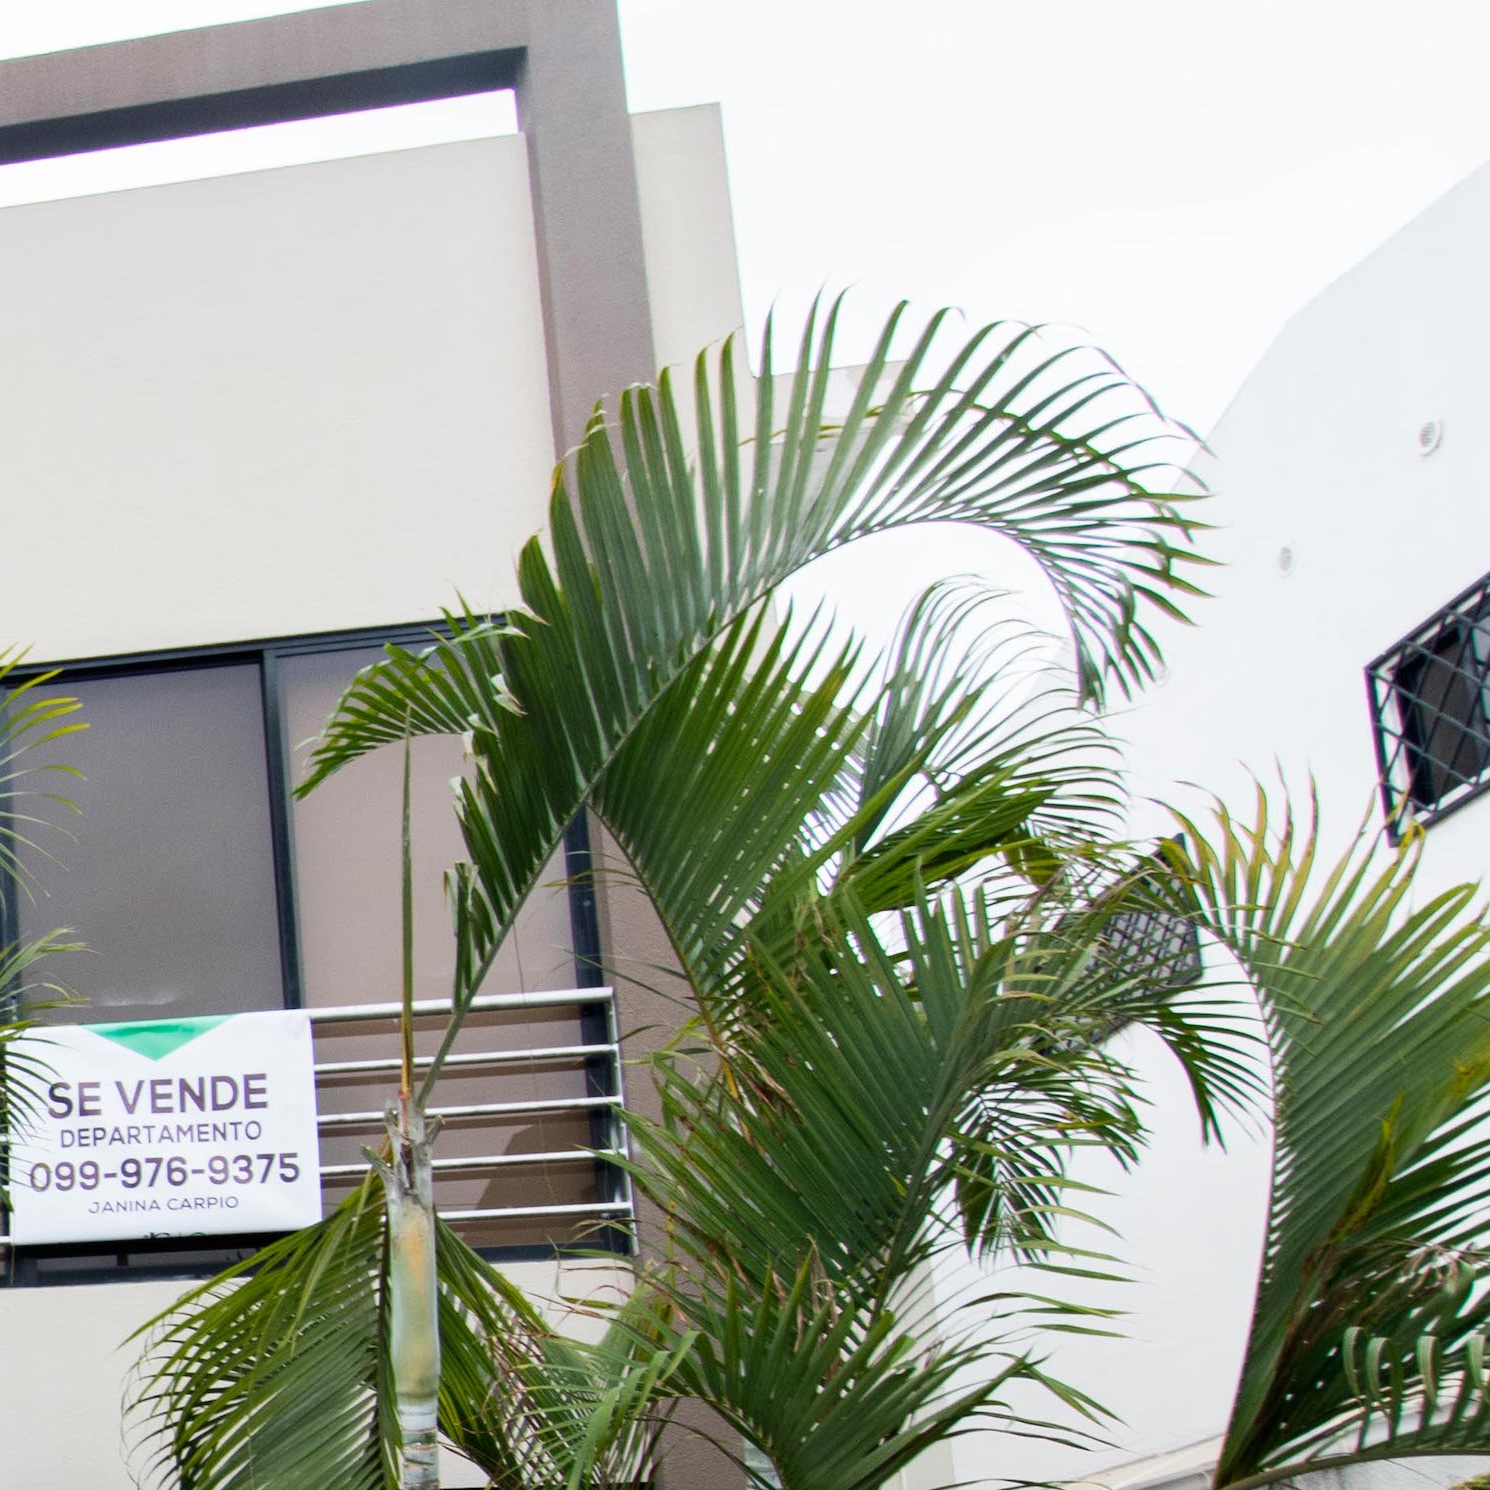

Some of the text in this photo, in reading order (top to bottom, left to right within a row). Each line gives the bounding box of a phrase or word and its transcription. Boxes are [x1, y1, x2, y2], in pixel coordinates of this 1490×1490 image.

[48, 1074, 267, 1117] SE VENDE
[61, 1121, 260, 1147] DEPARTAMENTO
[30, 1152, 299, 1191] 099-976-9375
[88, 1196, 238, 1214] JANINA CARPIO
